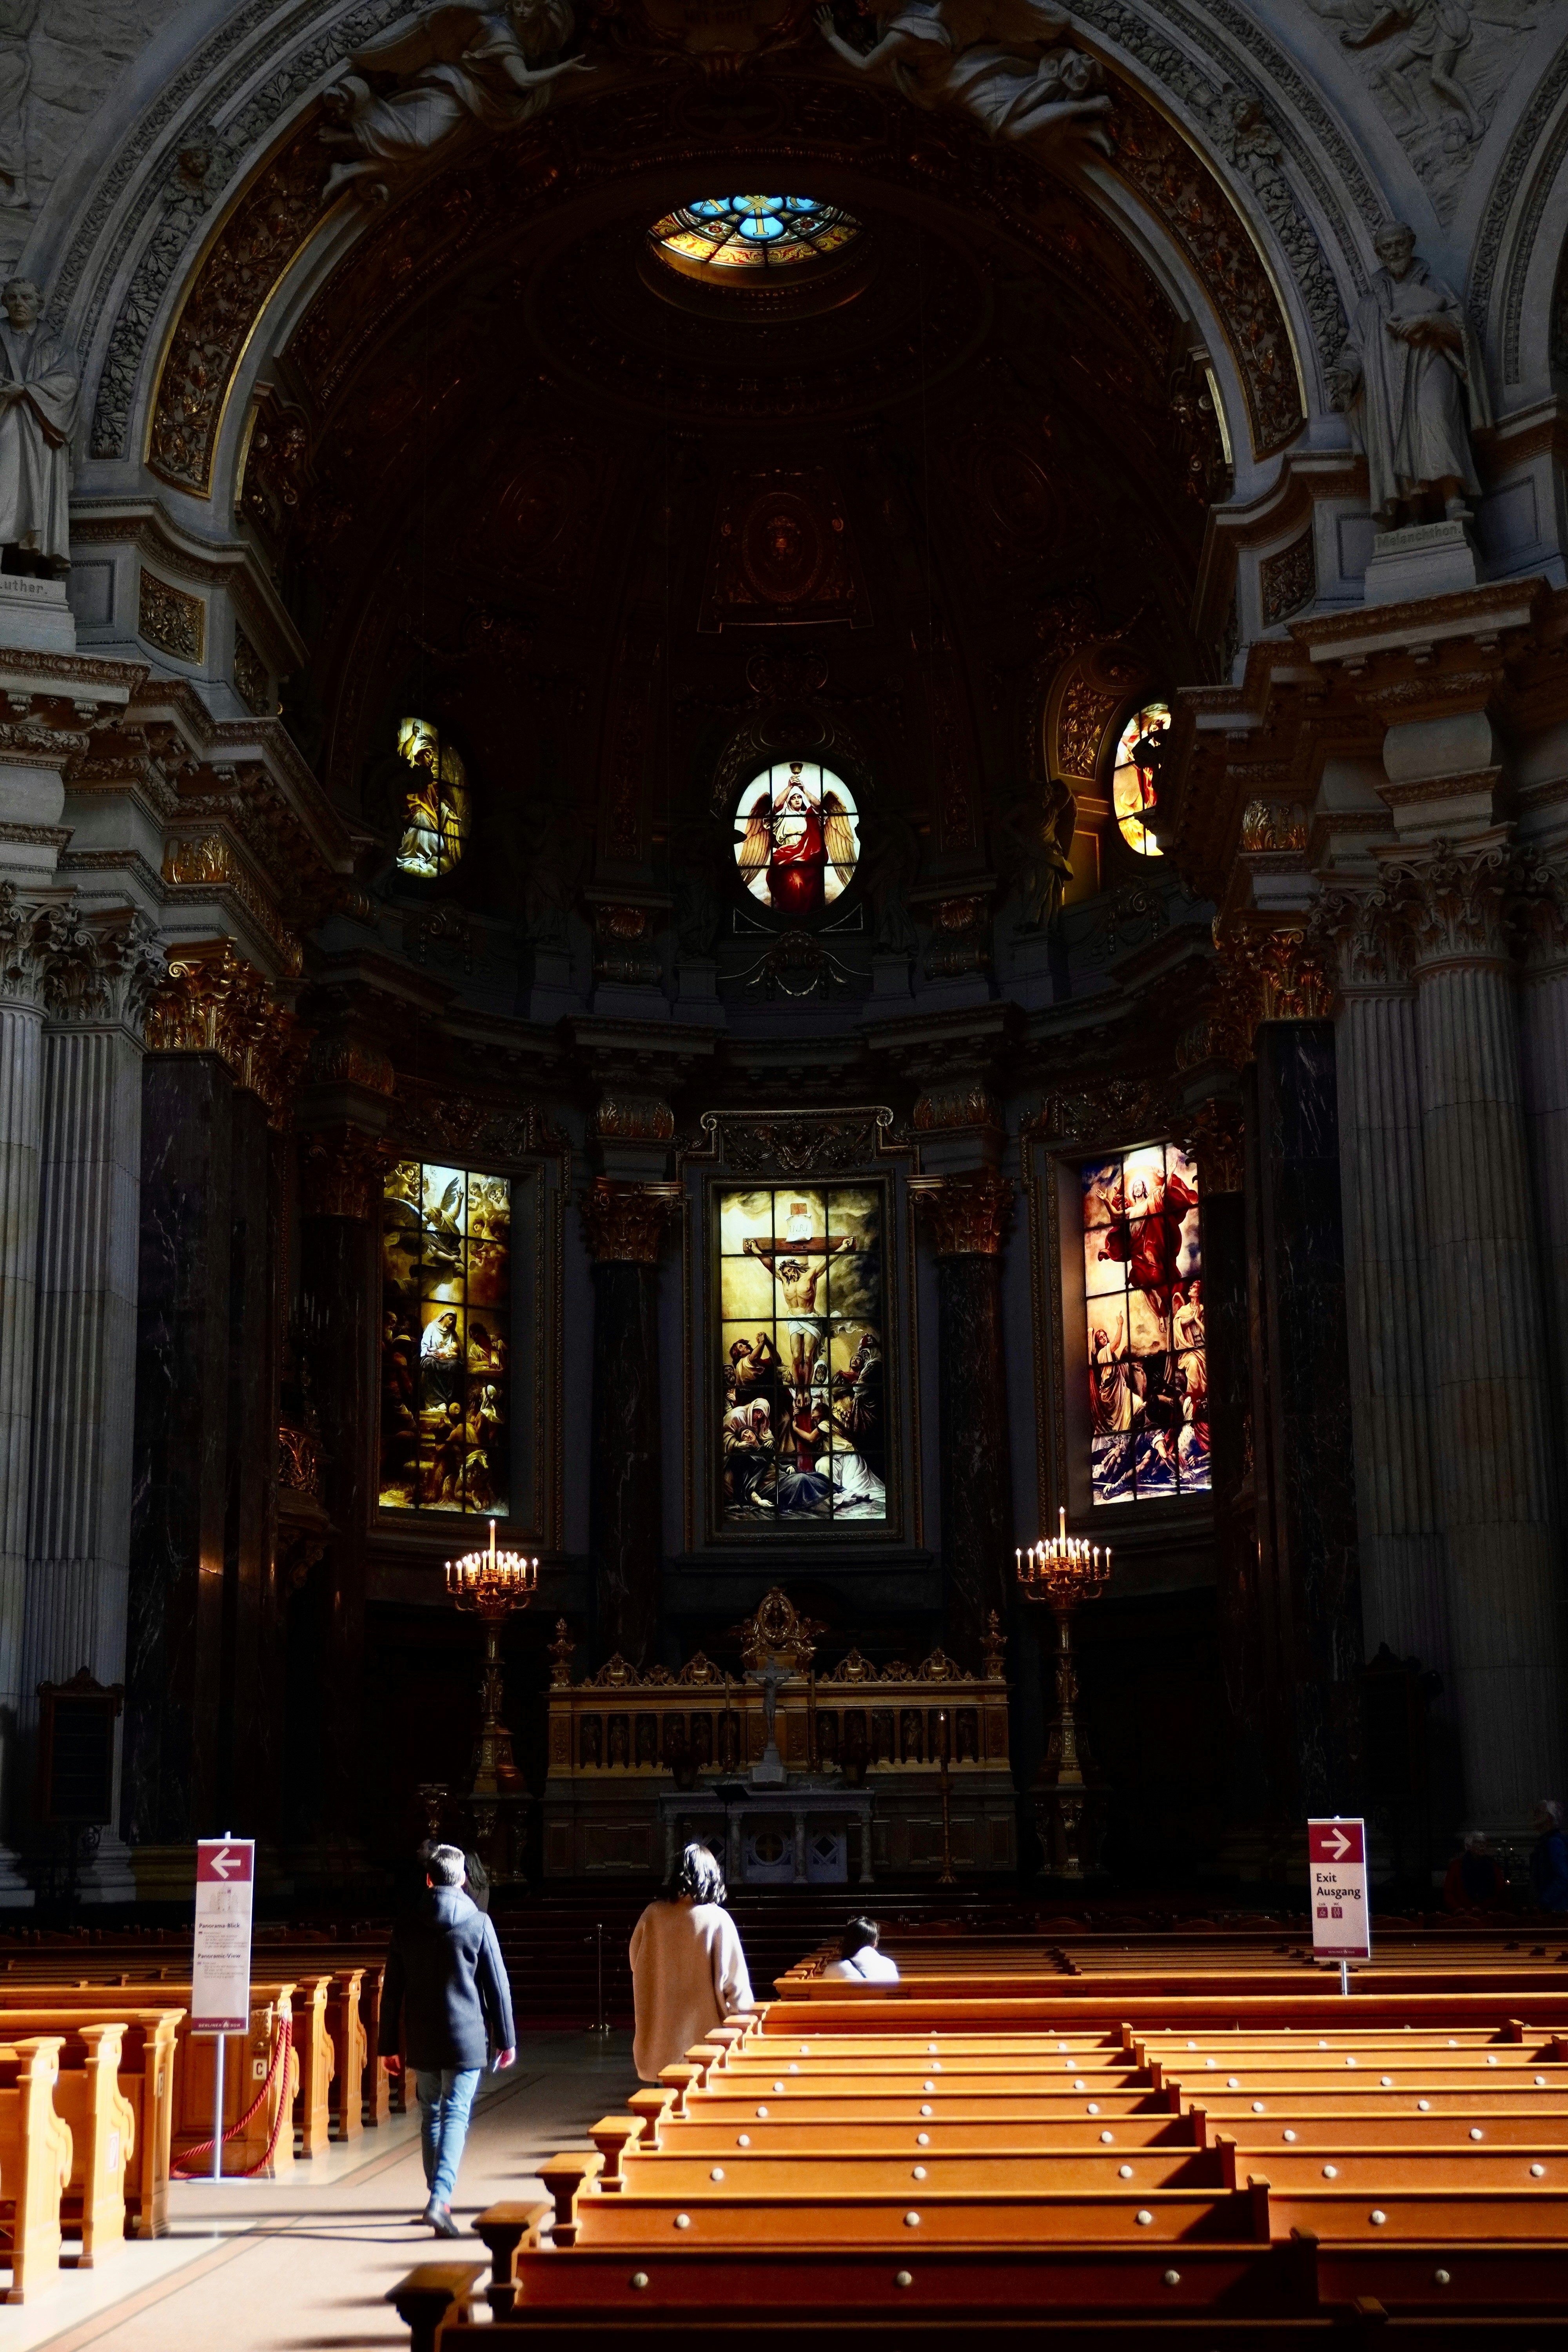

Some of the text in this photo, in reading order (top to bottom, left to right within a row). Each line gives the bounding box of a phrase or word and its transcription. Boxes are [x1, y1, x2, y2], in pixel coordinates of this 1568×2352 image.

[1317, 1872, 1337, 1882] Exit
[1317, 1886, 1361, 1900] Ausgang
[256, 2063, 263, 2076] C
